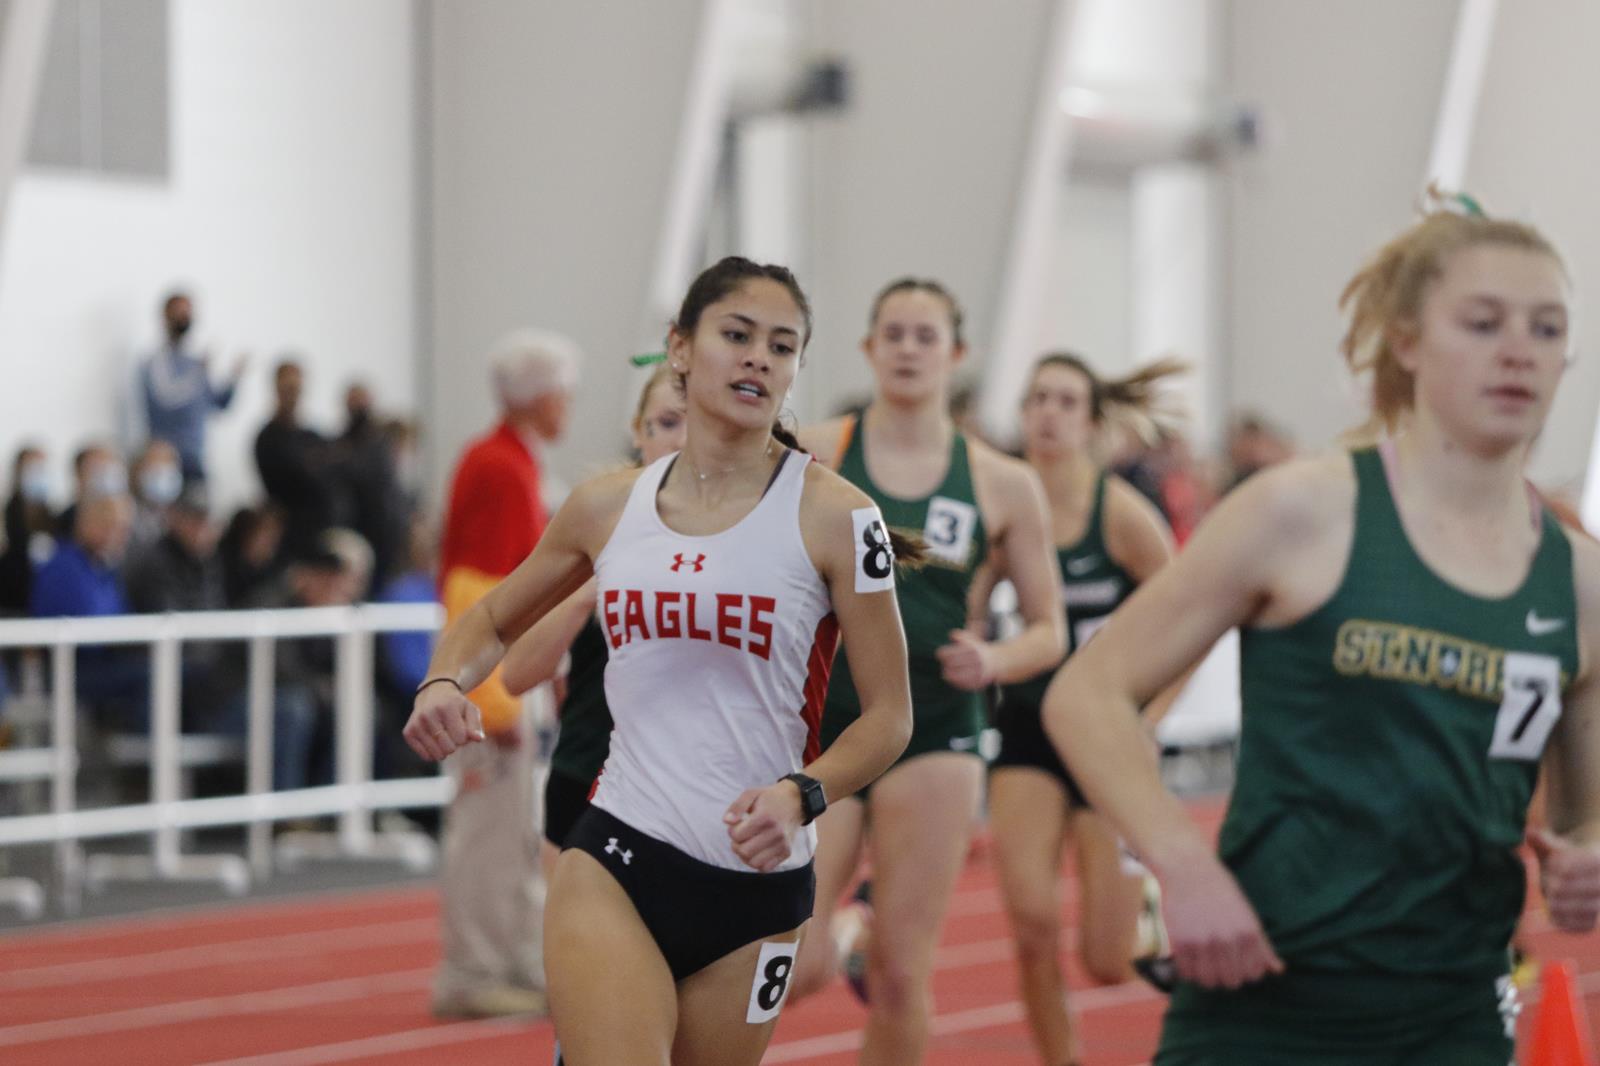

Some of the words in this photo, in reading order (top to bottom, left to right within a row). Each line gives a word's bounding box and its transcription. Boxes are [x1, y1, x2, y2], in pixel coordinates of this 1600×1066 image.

[862, 519, 896, 579] 8
[930, 508, 961, 547] 3
[603, 589, 777, 662] EAGLES
[1510, 676, 1548, 744] 7
[757, 954, 794, 1012] 8
